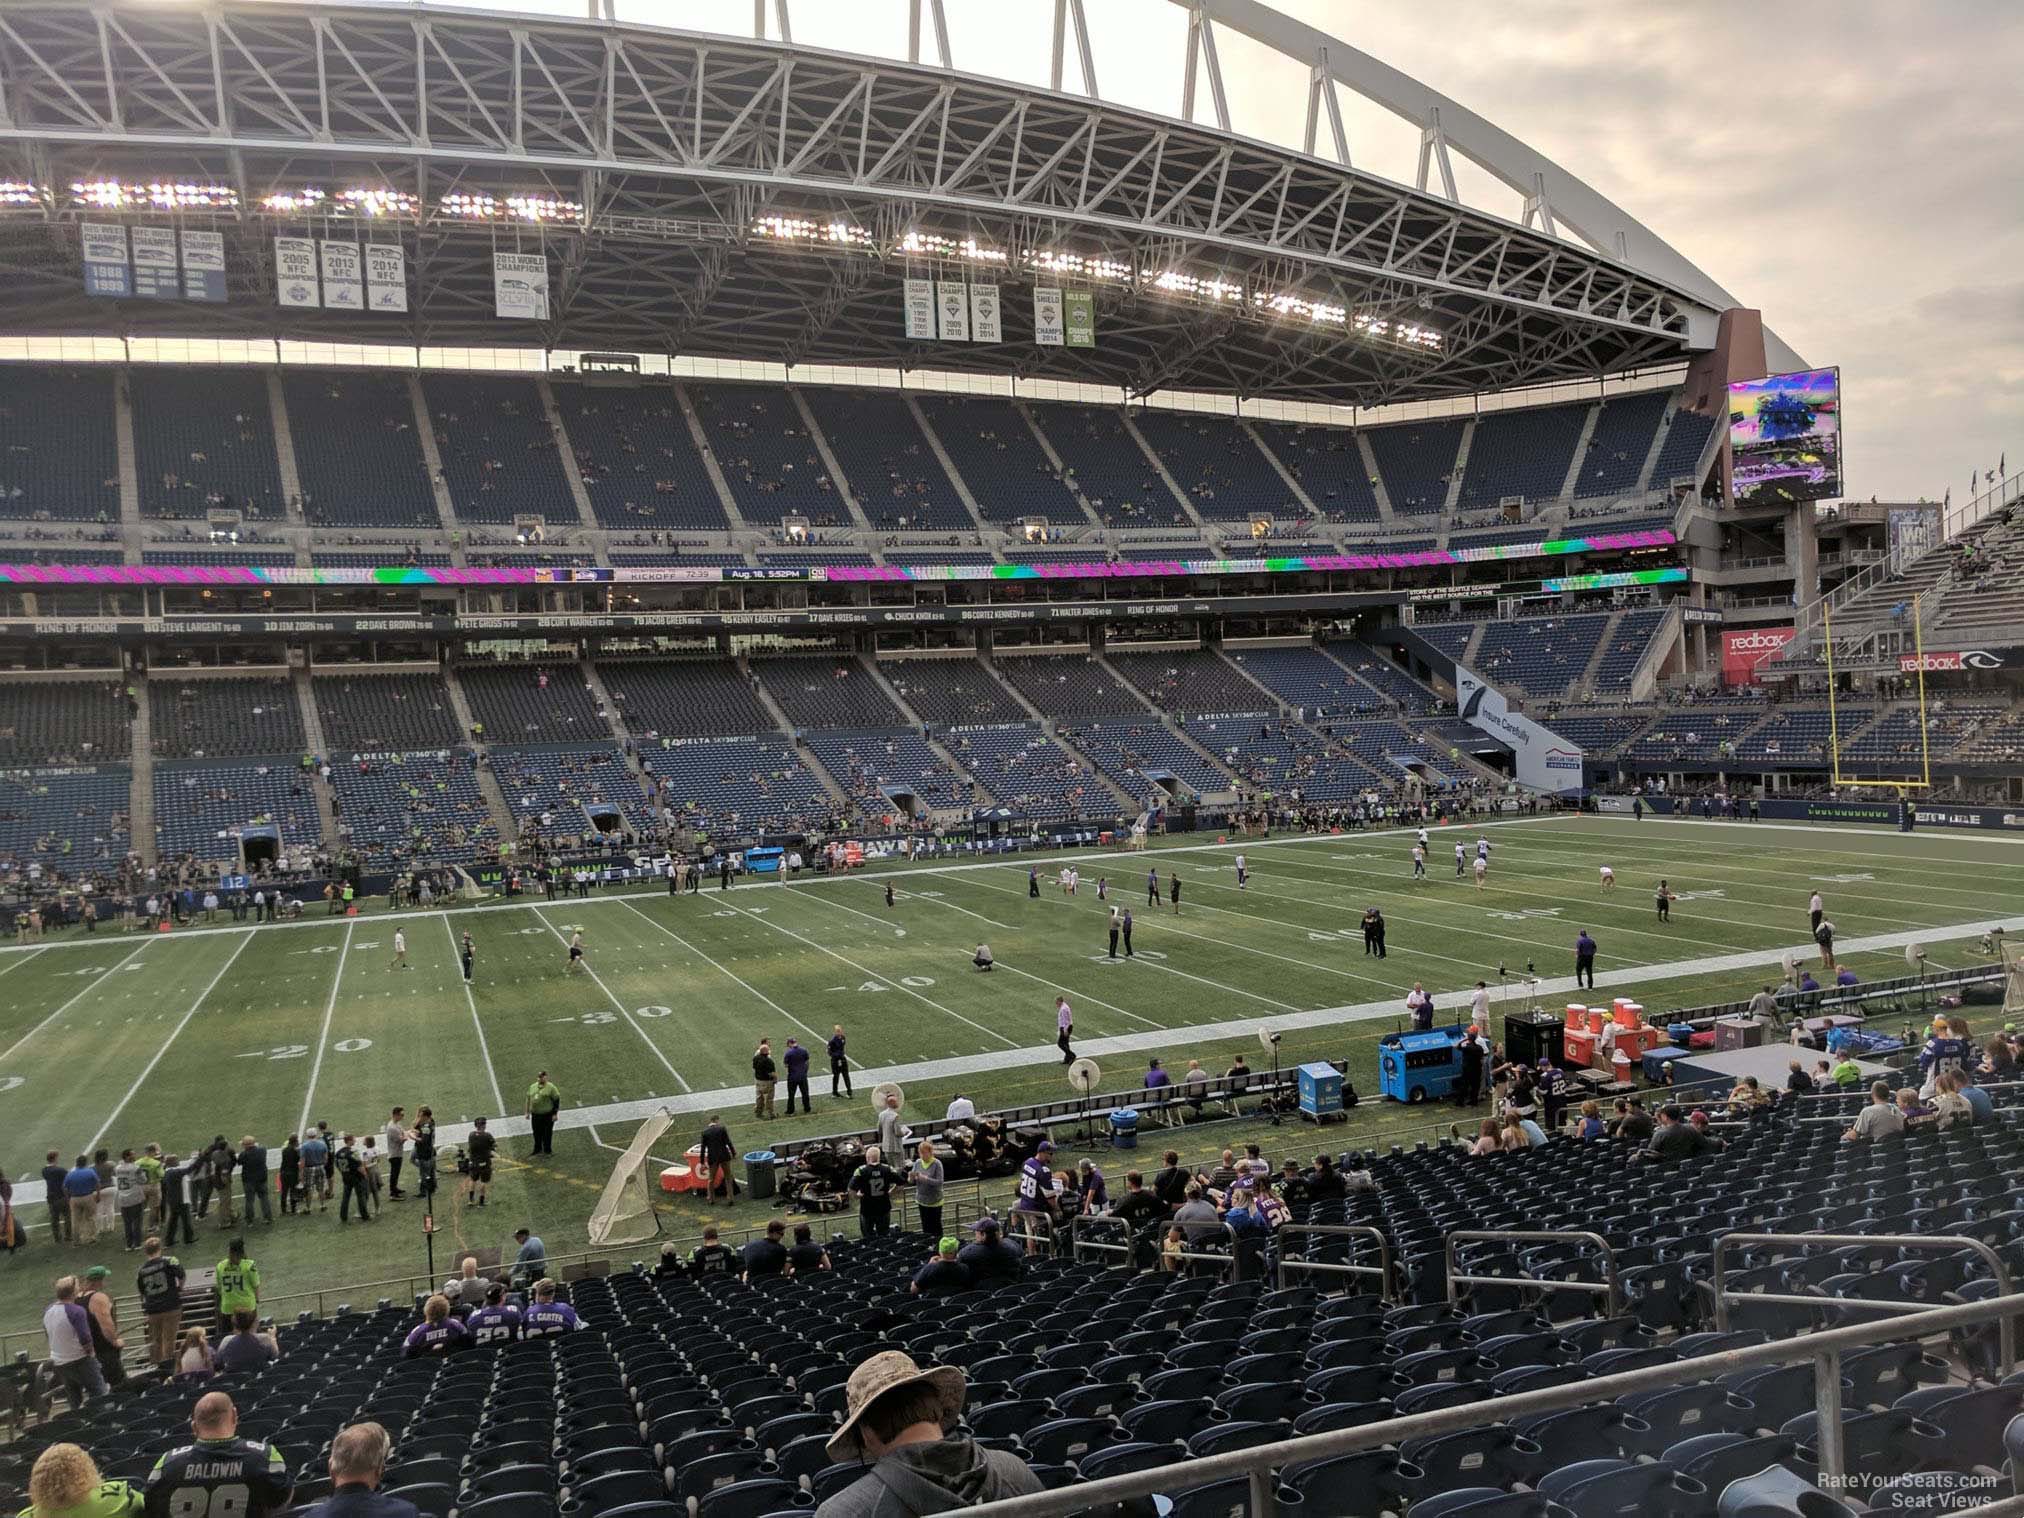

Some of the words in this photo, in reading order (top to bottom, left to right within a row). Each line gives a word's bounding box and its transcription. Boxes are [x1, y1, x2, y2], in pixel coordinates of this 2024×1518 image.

[283, 253, 310, 265] 2005
[328, 257, 355, 268] 2013
[496, 255, 516, 263] 2013
[518, 256, 545, 265] WORLD
[287, 264, 307, 273] NFC
[372, 260, 398, 271] 2014
[496, 263, 545, 273] CHAMPIONS
[333, 268, 352, 277] NFC
[377, 271, 396, 280] NFC
[947, 328, 962, 336] 2010
[980, 330, 996, 338] 2014
[631, 573, 676, 581] KICKOFF
[732, 570, 751, 580] Aug.
[973, 610, 994, 619] CORTEZ
[995, 609, 1020, 619] KENNEDY
[1051, 608, 1060, 617] 71
[1060, 608, 1081, 616] WALTER
[1082, 607, 1099, 616] JONES
[1127, 605, 1144, 615] RING
[1146, 605, 1155, 614] OF
[1156, 604, 1178, 614] HONOR
[645, 616, 665, 625] JACOB
[666, 615, 687, 625] GREEN
[733, 615, 753, 625] KENNY
[755, 614, 778, 624] EASLEY
[809, 613, 818, 622] 17
[819, 613, 834, 622] DAVE
[895, 612, 915, 620] CHUCK
[264, 622, 277, 631] 10
[356, 620, 369, 630] 22
[369, 620, 388, 630] DAVE
[389, 619, 416, 630] BROWN
[461, 619, 478, 629] PETE
[550, 617, 569, 627] CURT
[570, 617, 598, 627] WARNER
[35, 624, 63, 633] RING
[66, 624, 80, 633] OF
[82, 623, 118, 633] HONOR
[161, 622, 185, 633] STEVE
[187, 622, 222, 633] LARGENT
[1502, 719, 1530, 745] Carefully
[229, 876, 244, 889] 12
[1568, 1043, 1577, 1056] G
[1552, 1079, 1567, 1096] 22
[869, 1178, 885, 1197] 12
[1020, 1173, 1037, 1198] 28
[222, 1275, 244, 1293] 54
[537, 1313, 564, 1323] CARTER
[184, 1461, 243, 1480] BALDWIN
